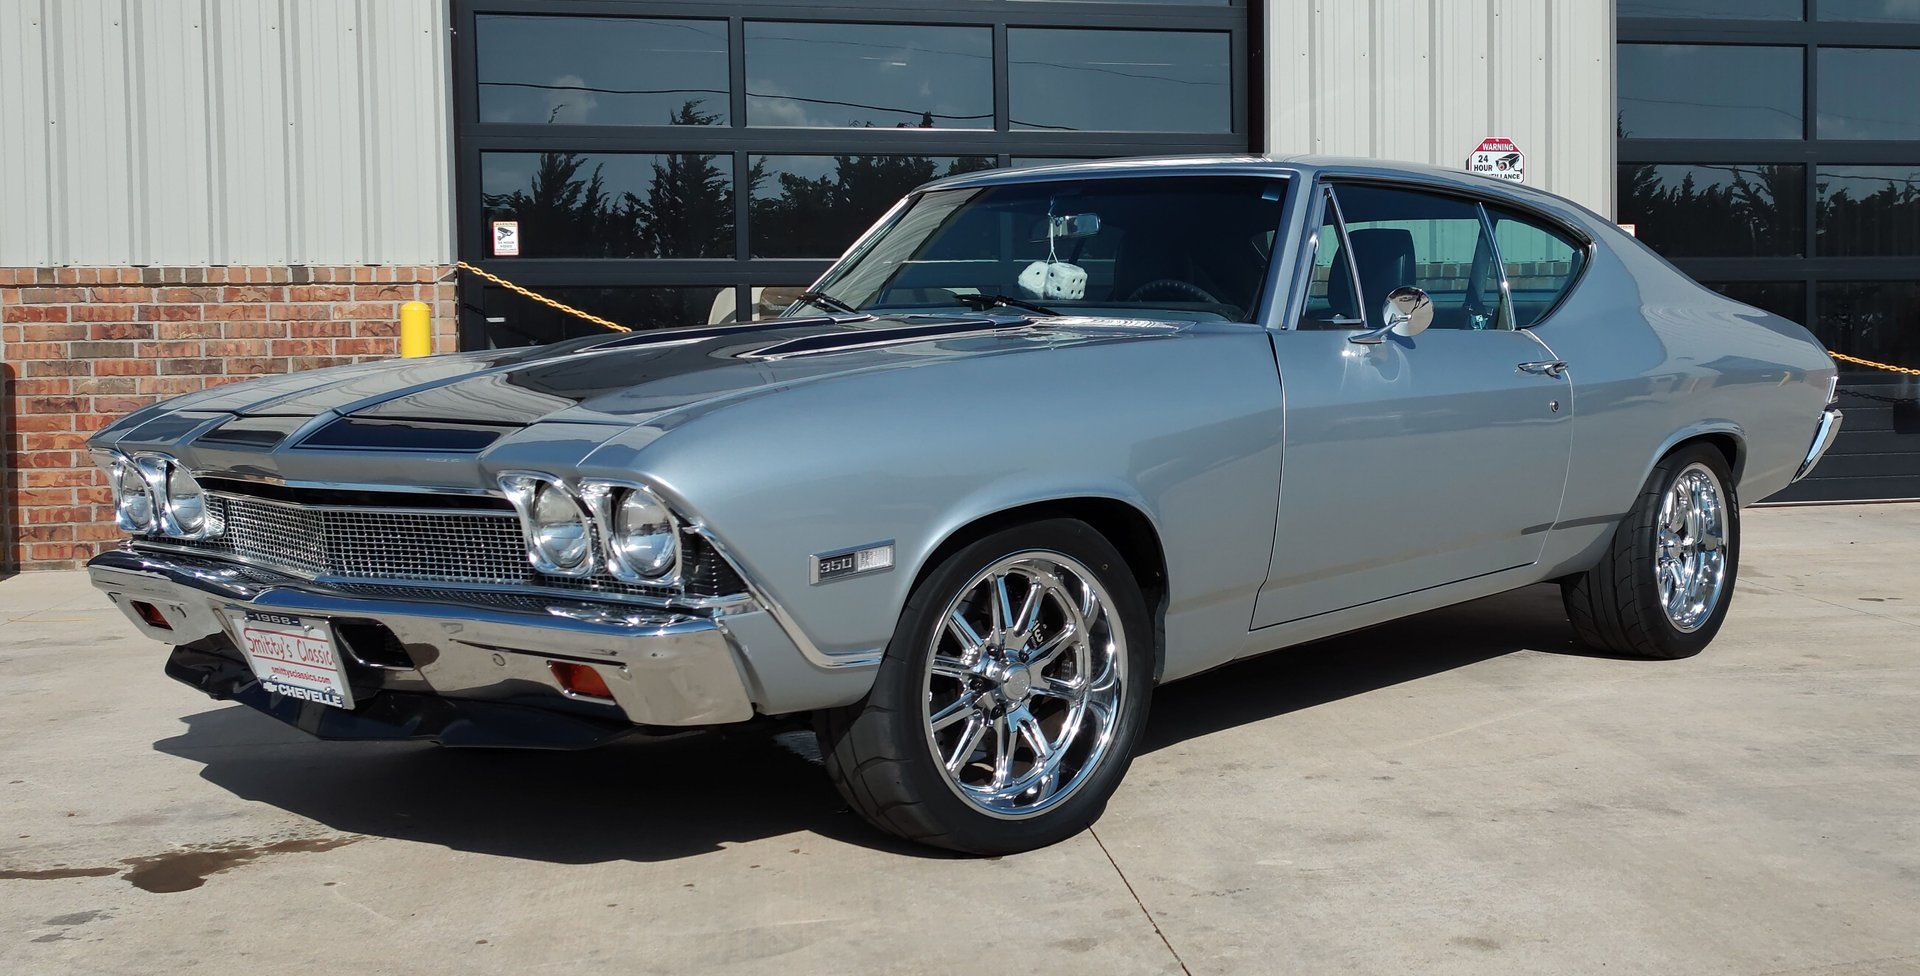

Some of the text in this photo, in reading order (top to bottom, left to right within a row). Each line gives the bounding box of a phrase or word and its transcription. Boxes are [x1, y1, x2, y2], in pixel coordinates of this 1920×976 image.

[1483, 143, 1514, 151] WARNING
[1478, 155, 1488, 163] 24
[820, 557, 852, 573] 350
[244, 627, 293, 660] Smitty's
[278, 684, 343, 708] CHEVELLE
